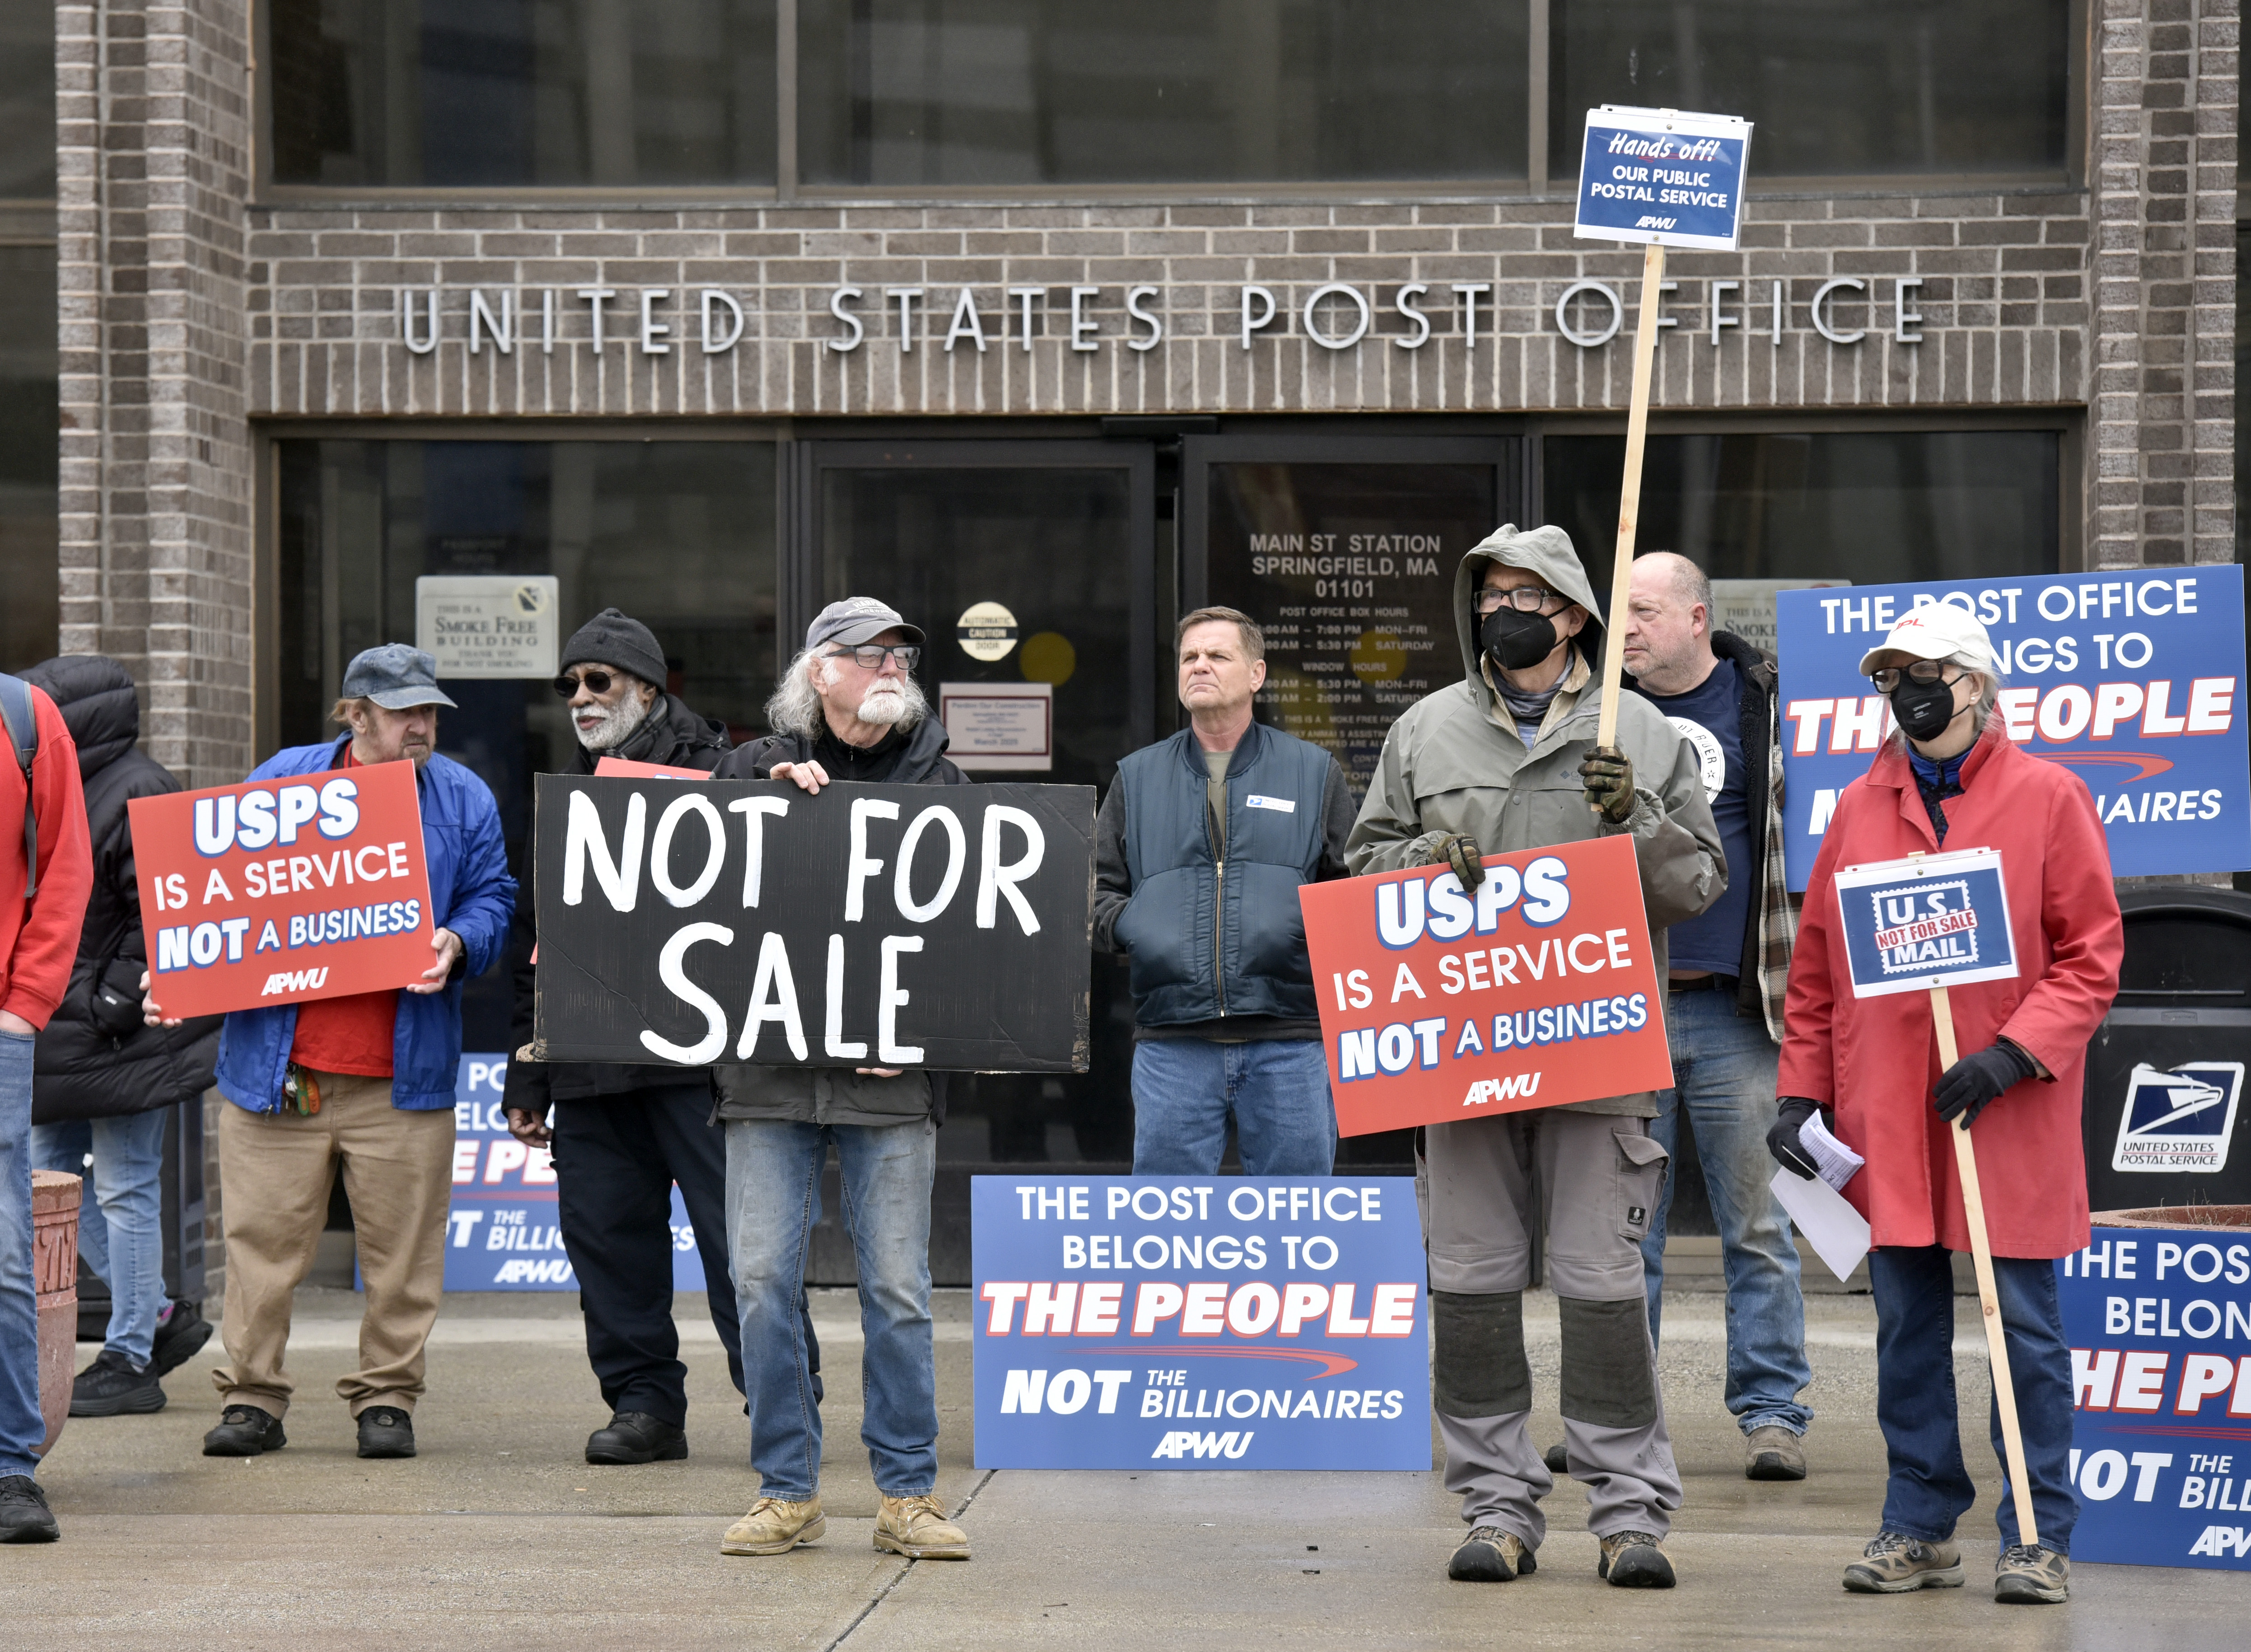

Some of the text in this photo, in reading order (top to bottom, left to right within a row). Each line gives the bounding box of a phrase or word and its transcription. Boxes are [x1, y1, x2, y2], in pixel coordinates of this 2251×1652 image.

[1608, 132, 1720, 161] Hands off!
[1612, 165, 1710, 187] OUR PUBLIC
[1591, 182, 1727, 208] POSTAL SERVICE
[1635, 215, 1677, 229] APWU
[404, 278, 1923, 354] UNITED STATES POST OFFICE
[1249, 534, 1440, 553] MAIN ST STATION
[1252, 556, 1439, 579] SPRINGFIELD, MA
[1315, 579, 1374, 598] 01101
[1280, 607, 1409, 617] POST OFFICE BOX HOURS
[1820, 595, 1895, 634] THE
[2037, 579, 2197, 622] OFFICE
[1344, 625, 1362, 635] PM
[1344, 640, 1362, 650] PM
[1375, 640, 1435, 651] SATURDAY
[2093, 632, 2153, 669] TO
[1302, 662, 1387, 672] WINDOW HOURS
[1344, 679, 1362, 689] PM
[1344, 693, 1362, 703] PM
[1997, 676, 2237, 744] EOPLE
[193, 778, 360, 858] USPS
[154, 841, 410, 911] IS A SERVICE
[562, 790, 1046, 936] NOT FOR
[1374, 855, 1570, 952] USPS
[1887, 892, 1958, 925] U.S.
[156, 899, 420, 974] NOT A BUSINESS
[1878, 911, 1975, 948] NOT FOR SALE
[1894, 937, 1966, 965] MAIL
[261, 966, 329, 996] APWU
[1333, 928, 1633, 1011] IS A SERVICE
[639, 921, 925, 1065] SALE
[1339, 992, 1648, 1083] NOT A BUSINESS
[468, 1062, 508, 1092] PO
[1462, 1072, 1542, 1106] APWU
[2120, 1155, 2218, 1166] POSTAL SERVICE
[2123, 1142, 2215, 1153] UNITED STATES
[493, 1210, 528, 1225] THE
[1016, 1186, 1382, 1221] THE POST OFFICE
[1063, 1235, 1339, 1270] BELONGS TO
[2156, 1242, 2250, 1284] POS
[980, 1281, 1419, 1339] THE PEOPLE
[2105, 1296, 2251, 1340] BELON
[1000, 1369, 1187, 1415] NOT THE
[2069, 1348, 2170, 1414] HE
[1140, 1389, 1404, 1420] BILLIONAIRES
[1150, 1431, 1255, 1459] APWU
[2189, 1454, 2233, 1474] THE
